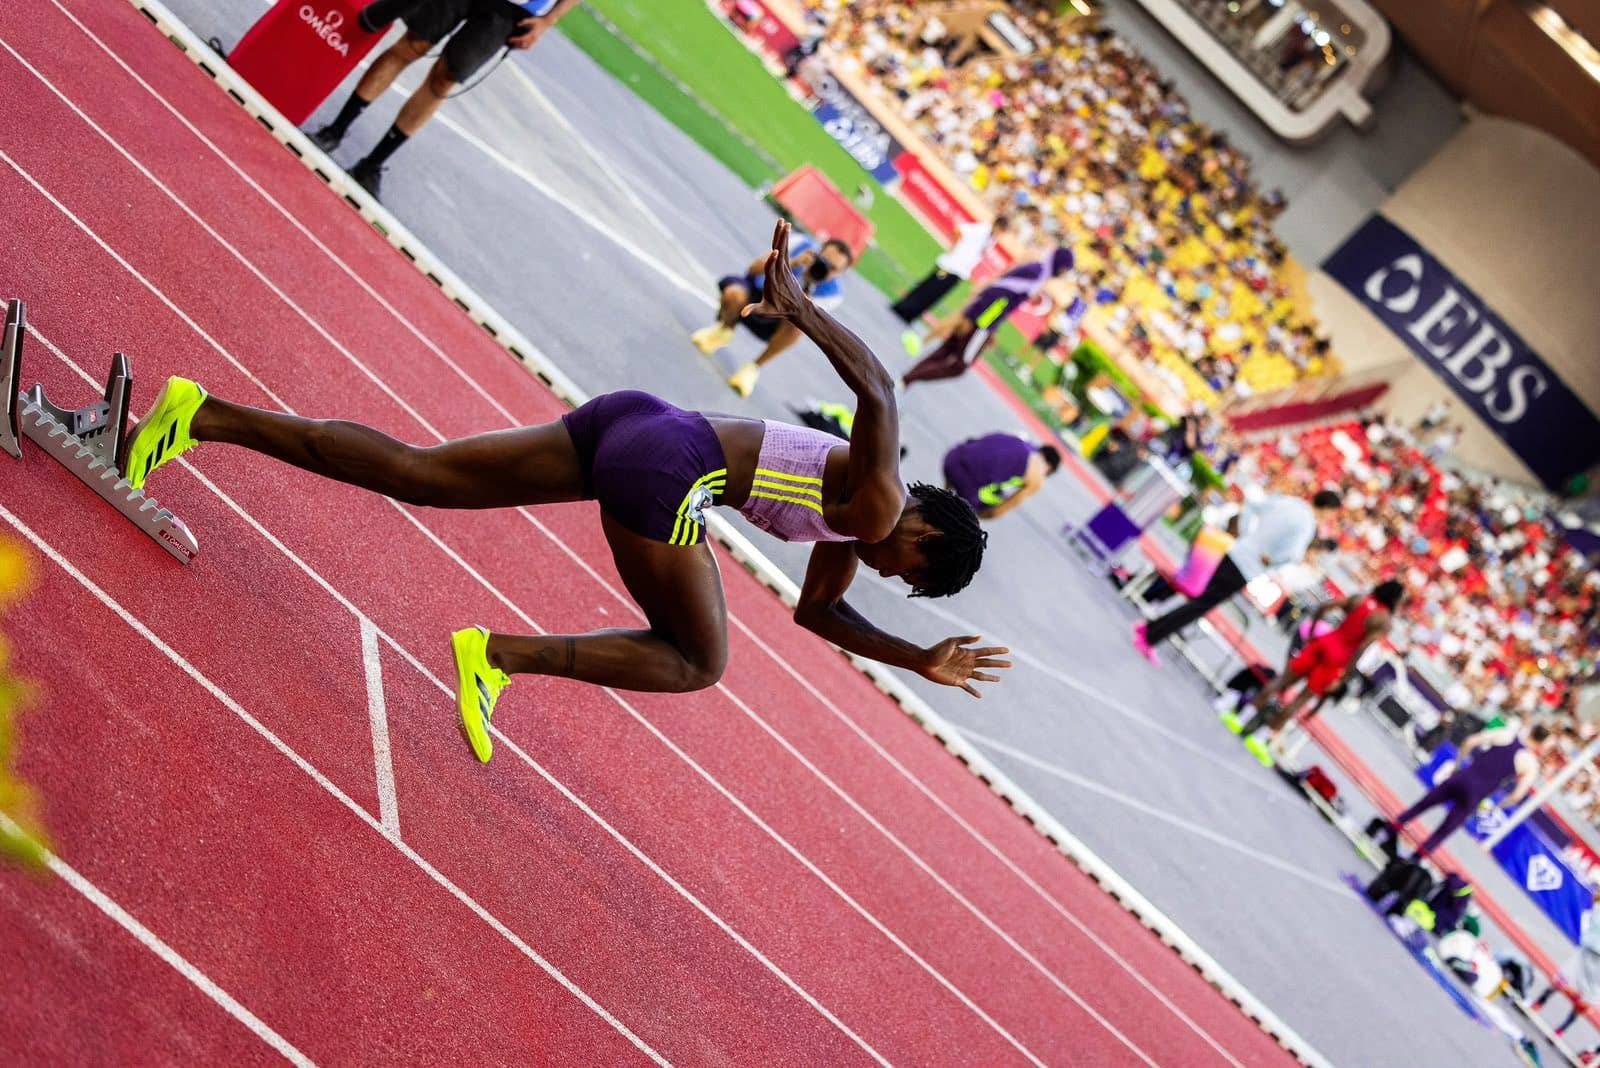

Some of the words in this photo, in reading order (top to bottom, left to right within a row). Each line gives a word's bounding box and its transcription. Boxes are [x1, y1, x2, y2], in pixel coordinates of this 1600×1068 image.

[299, 4, 348, 57] OMEGA
[1406, 283, 1548, 424] EBS
[169, 537, 190, 558] OMEGA
